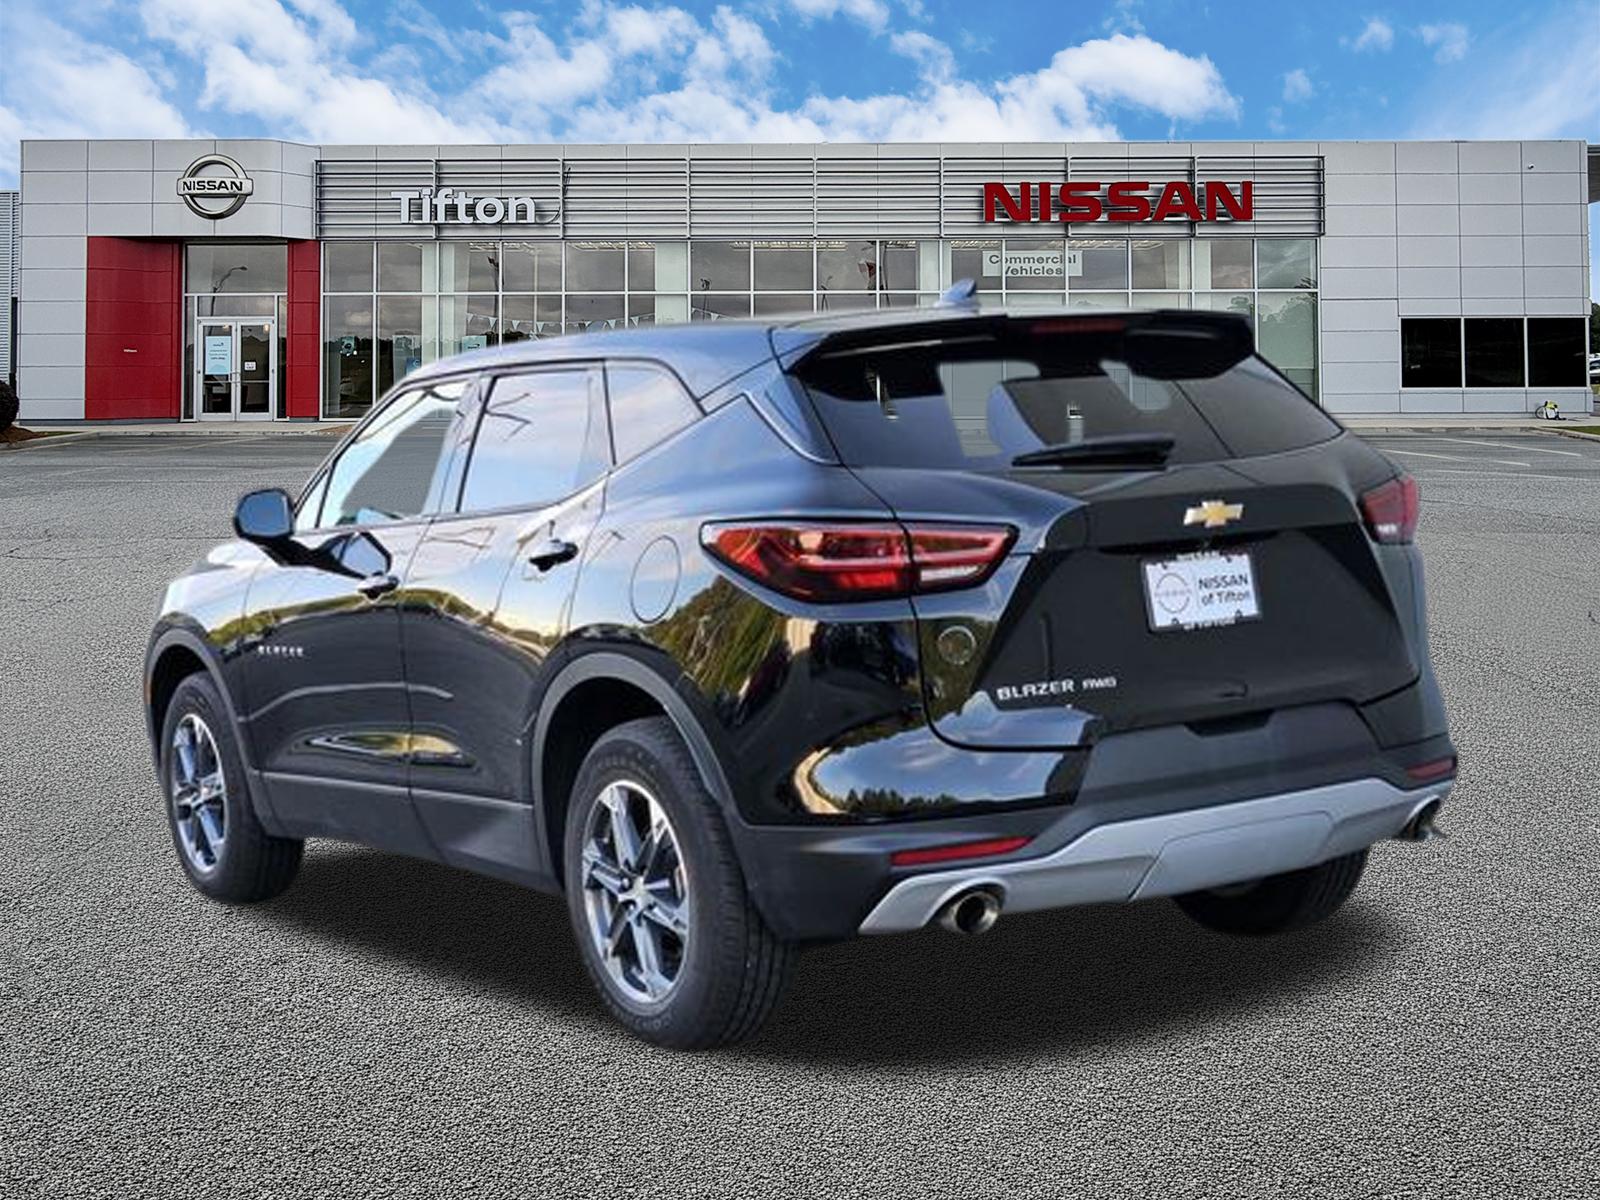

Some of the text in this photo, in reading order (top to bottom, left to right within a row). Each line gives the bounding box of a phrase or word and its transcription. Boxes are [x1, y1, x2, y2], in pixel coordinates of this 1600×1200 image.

[182, 180, 243, 191] NISSAN
[390, 187, 536, 224] Tifton
[984, 180, 1253, 222] NISSAN
[1199, 573, 1248, 590] NISSAN
[996, 678, 1075, 700] BLAZER
